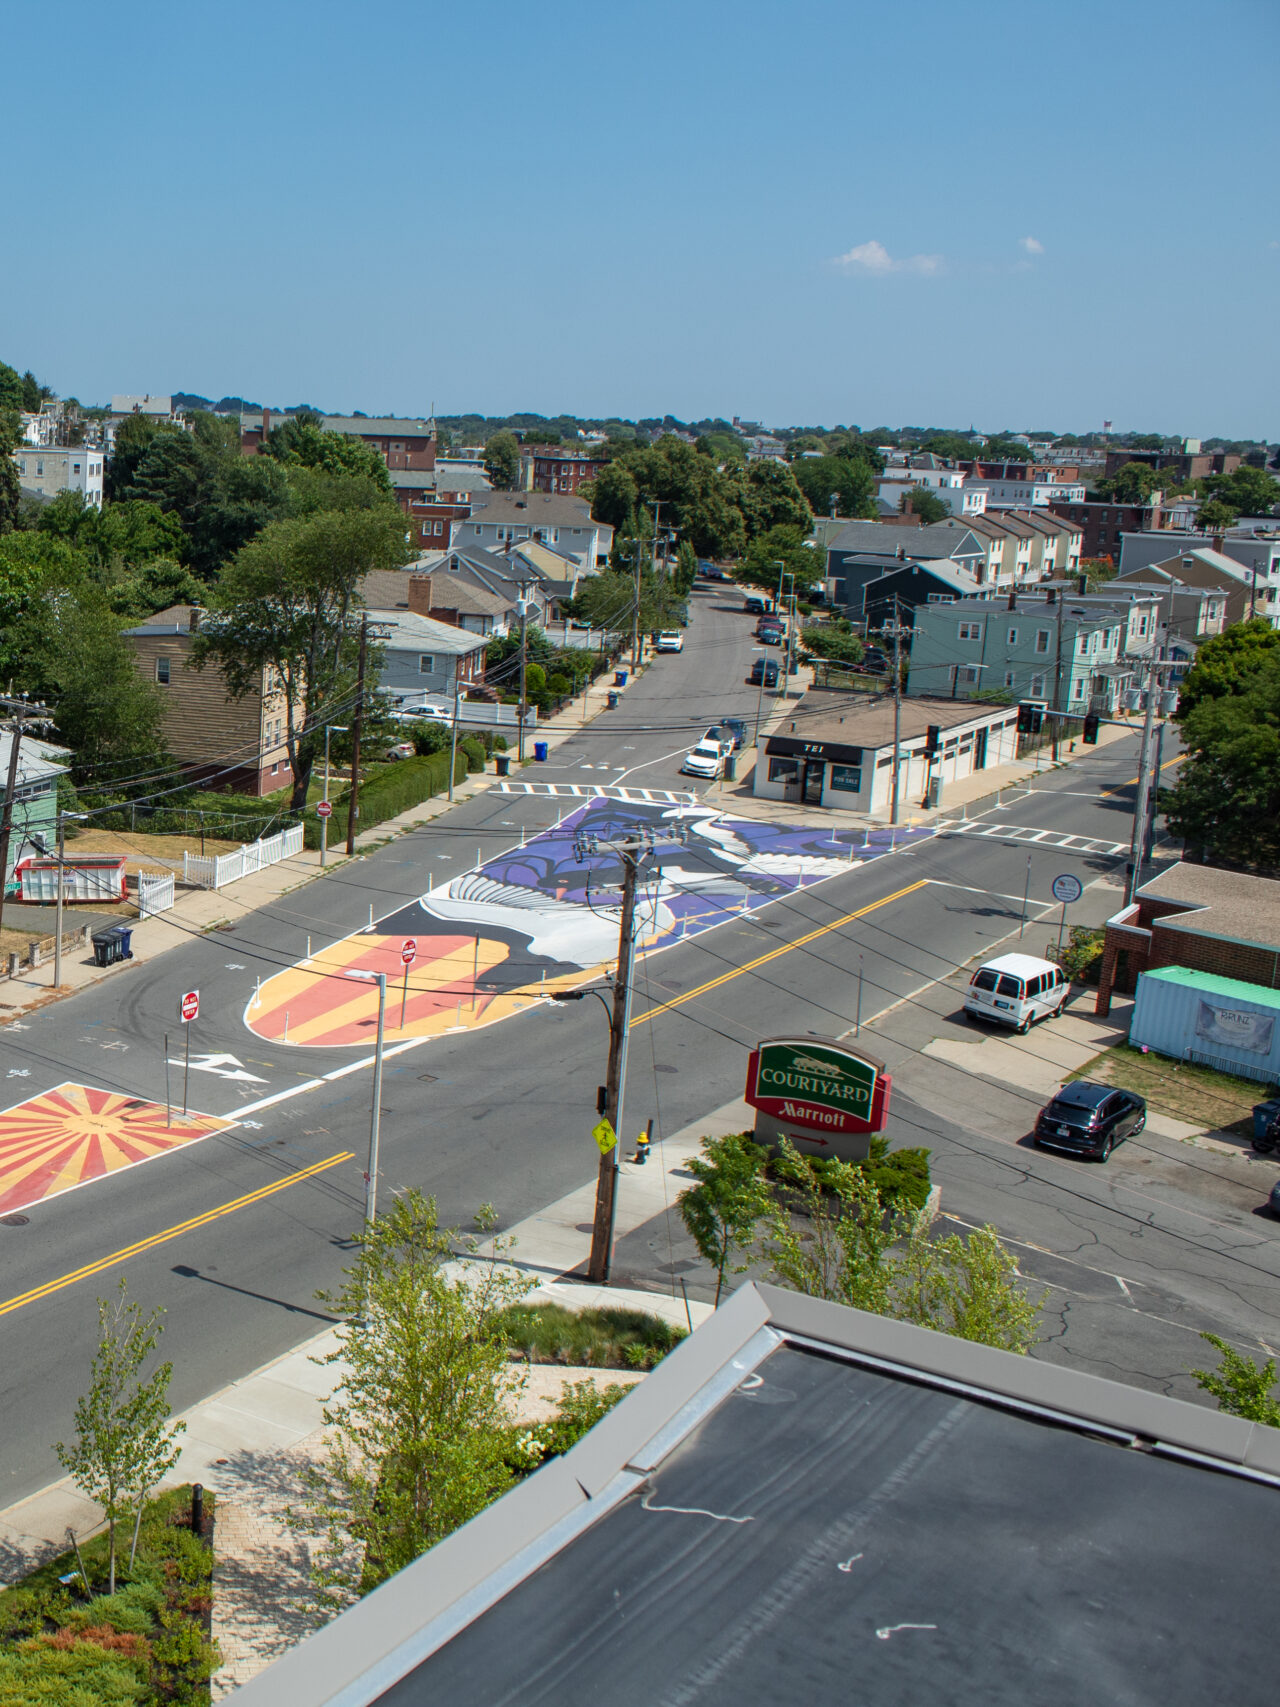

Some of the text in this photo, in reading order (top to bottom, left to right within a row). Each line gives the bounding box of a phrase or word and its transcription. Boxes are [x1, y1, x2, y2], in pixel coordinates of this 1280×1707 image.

[804, 744, 824, 753] TEI
[185, 1008, 195, 1016] ENTER
[761, 1068, 869, 1102] COURTYARD
[778, 1101, 845, 1128] Marriott
